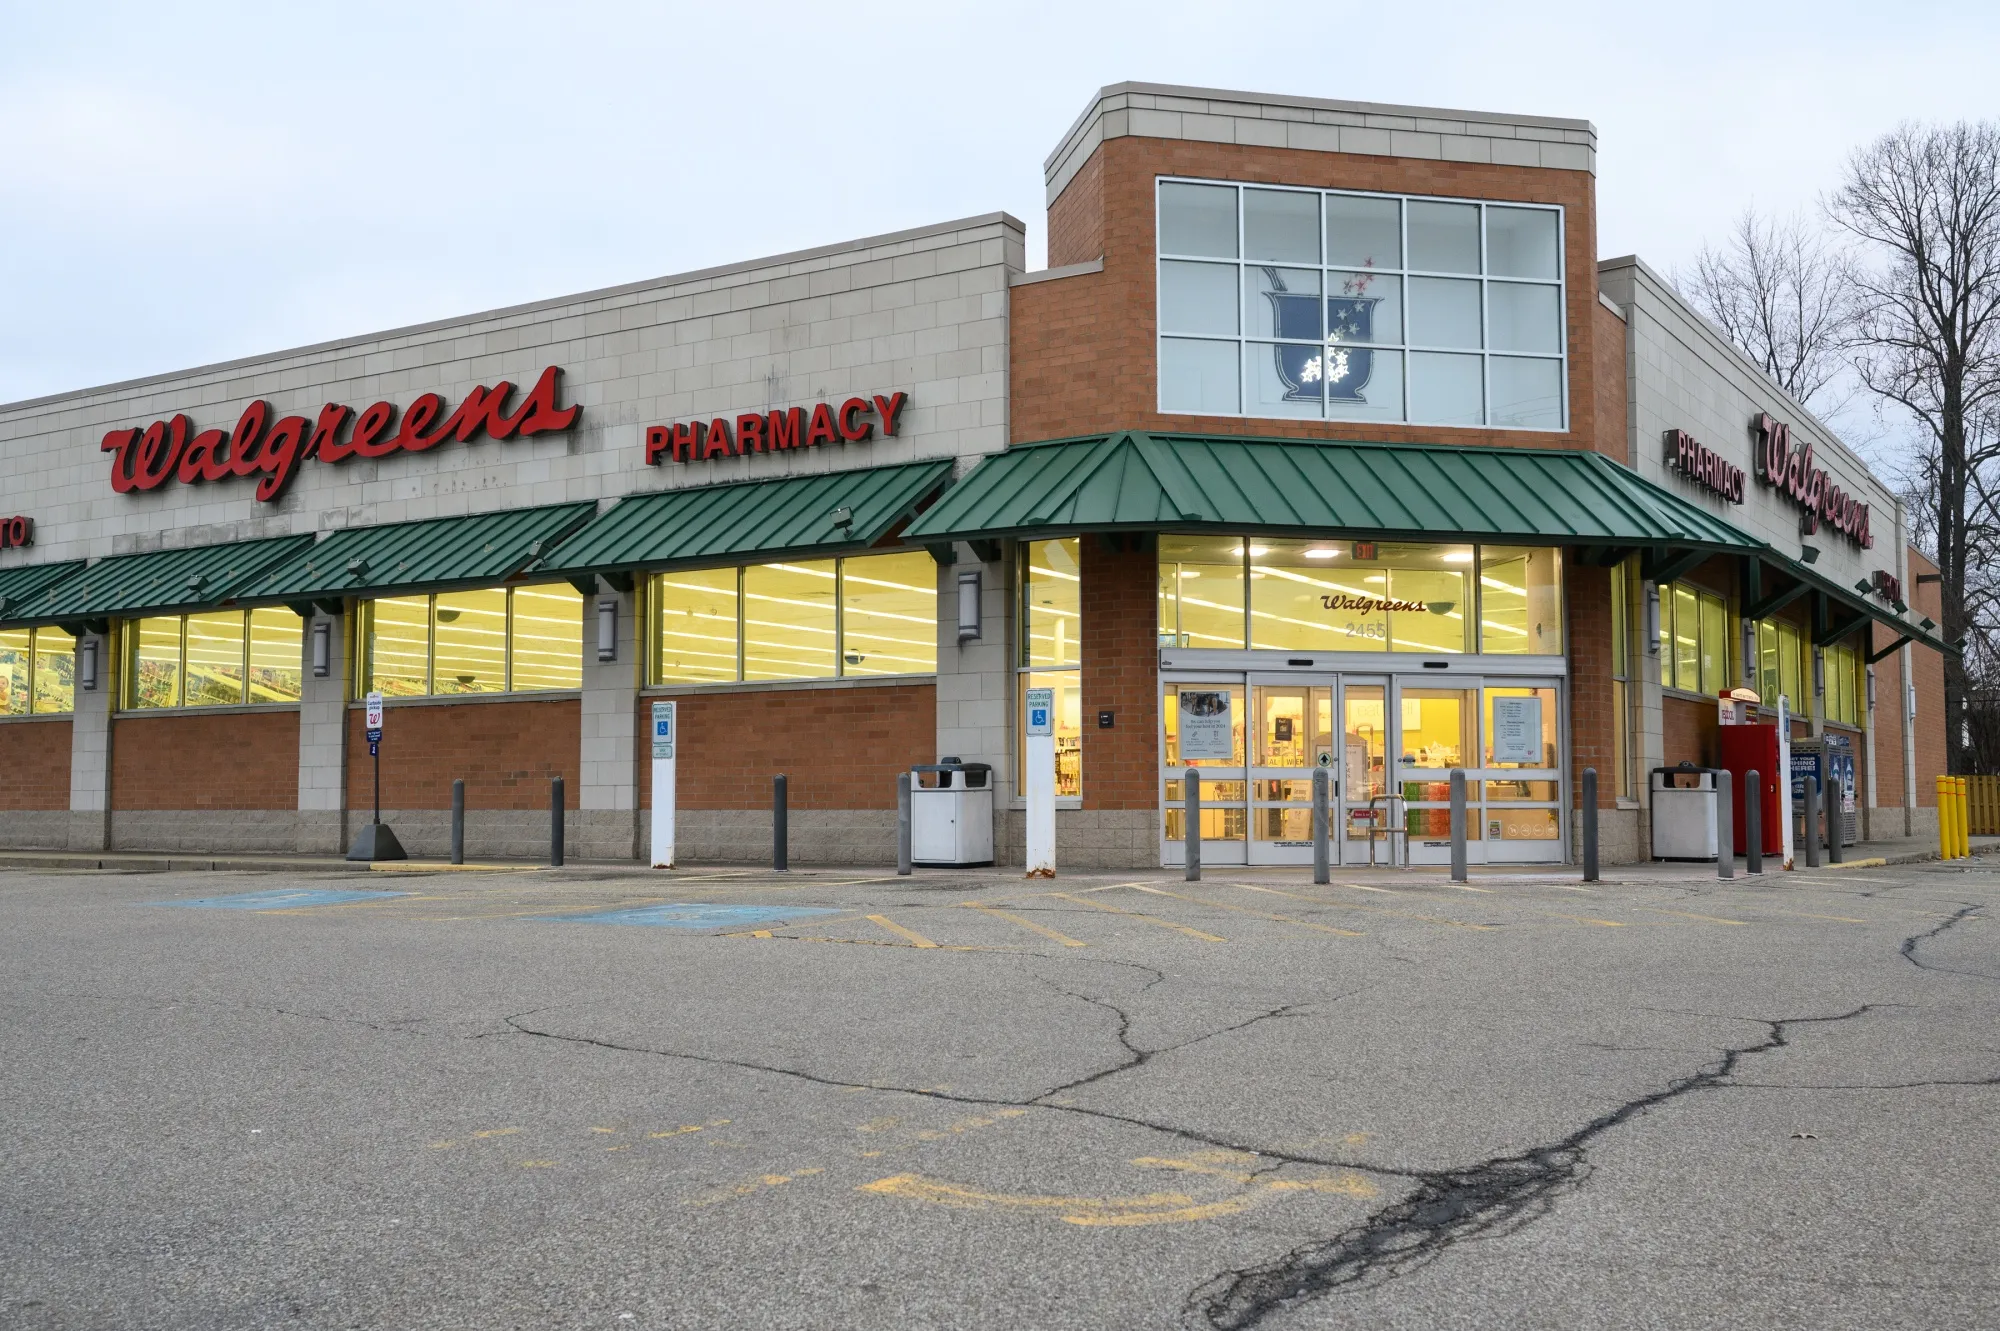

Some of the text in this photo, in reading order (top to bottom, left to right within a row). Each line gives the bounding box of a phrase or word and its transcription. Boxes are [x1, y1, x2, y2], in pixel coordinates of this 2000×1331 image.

[100, 366, 584, 502] Walgreens
[645, 392, 908, 466] PHARMACY
[1676, 429, 1746, 505] PHARMACY
[1754, 412, 1874, 549] Walgreens
[1355, 543, 1375, 560] EXIT
[1320, 594, 1427, 615] Walgreens
[1345, 621, 1386, 638] 2455
